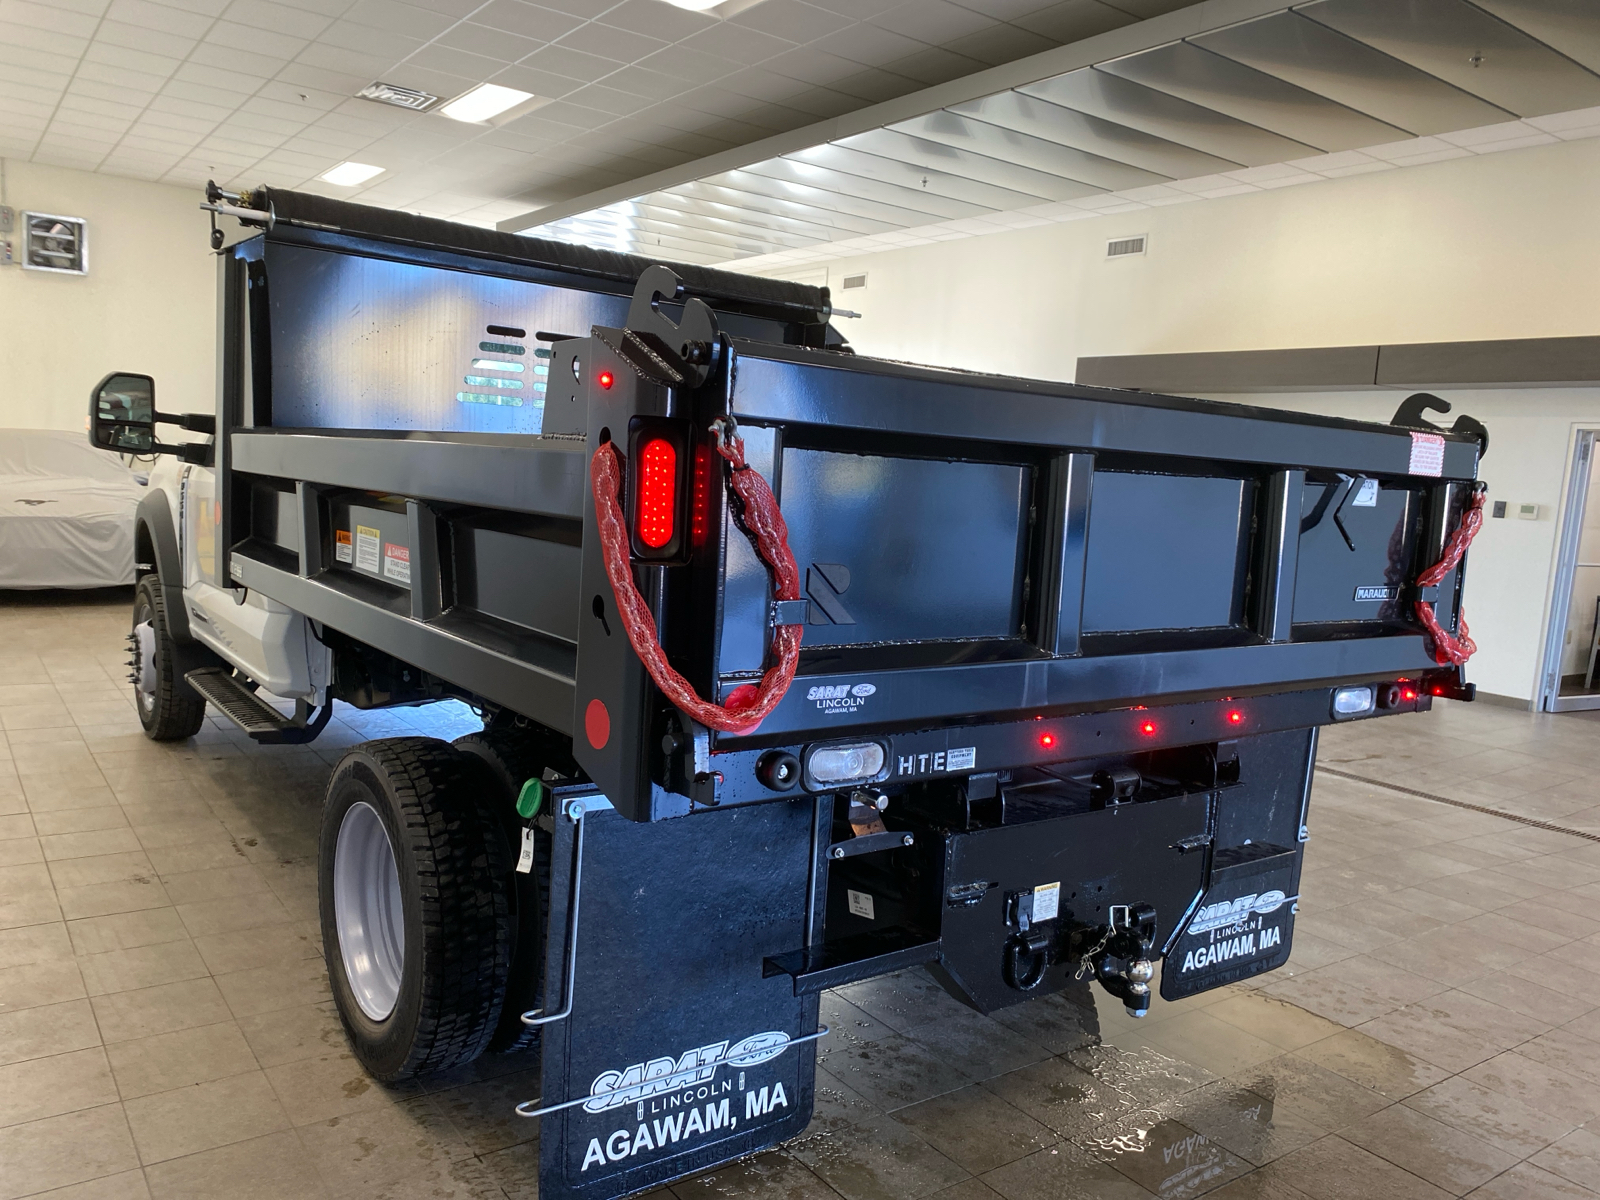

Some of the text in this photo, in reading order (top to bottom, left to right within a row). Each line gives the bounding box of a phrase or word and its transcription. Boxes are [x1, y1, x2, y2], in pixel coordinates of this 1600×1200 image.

[391, 546, 409, 560] DANGER
[807, 684, 874, 700] SARAT Ford
[816, 697, 865, 708] LINCOLN
[1187, 893, 1258, 935] SARAT
[1182, 926, 1281, 973] AGAWAM, MA
[583, 1033, 785, 1113] SARAT Ford
[651, 1079, 731, 1114] LINCOLN
[581, 1081, 788, 1172] AGAWAM, MA
